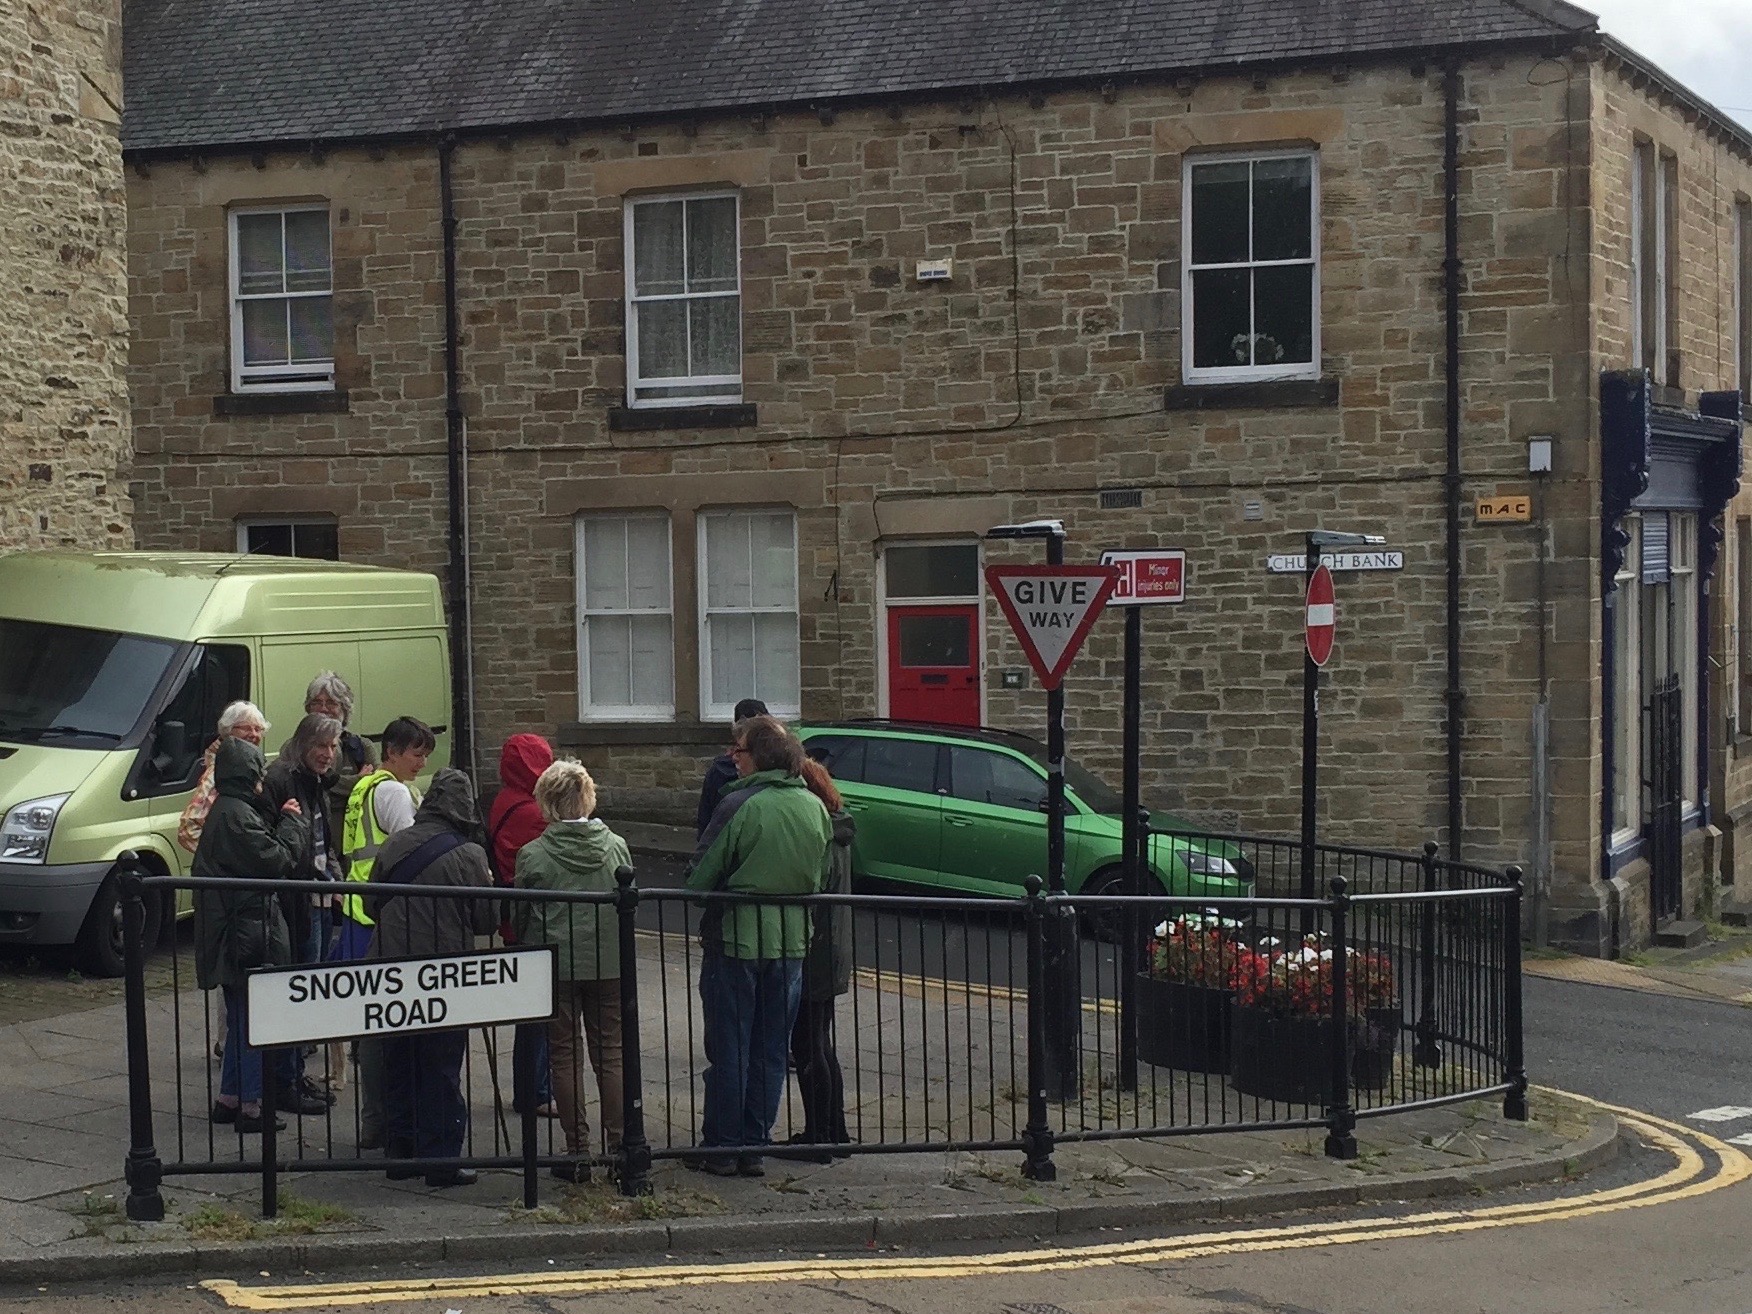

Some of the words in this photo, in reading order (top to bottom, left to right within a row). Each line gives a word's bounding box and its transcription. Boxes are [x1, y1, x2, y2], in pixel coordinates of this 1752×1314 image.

[1272, 556, 1344, 570] CHUCH
[1352, 554, 1398, 568] BANK
[1014, 580, 1087, 605] GIVE
[1137, 579, 1163, 593] injuries
[1164, 579, 1179, 593] only
[1029, 612, 1075, 628] WAY
[288, 966, 404, 1002] SNOWS
[417, 957, 518, 991] GREEN
[364, 997, 448, 1030] ROAD
